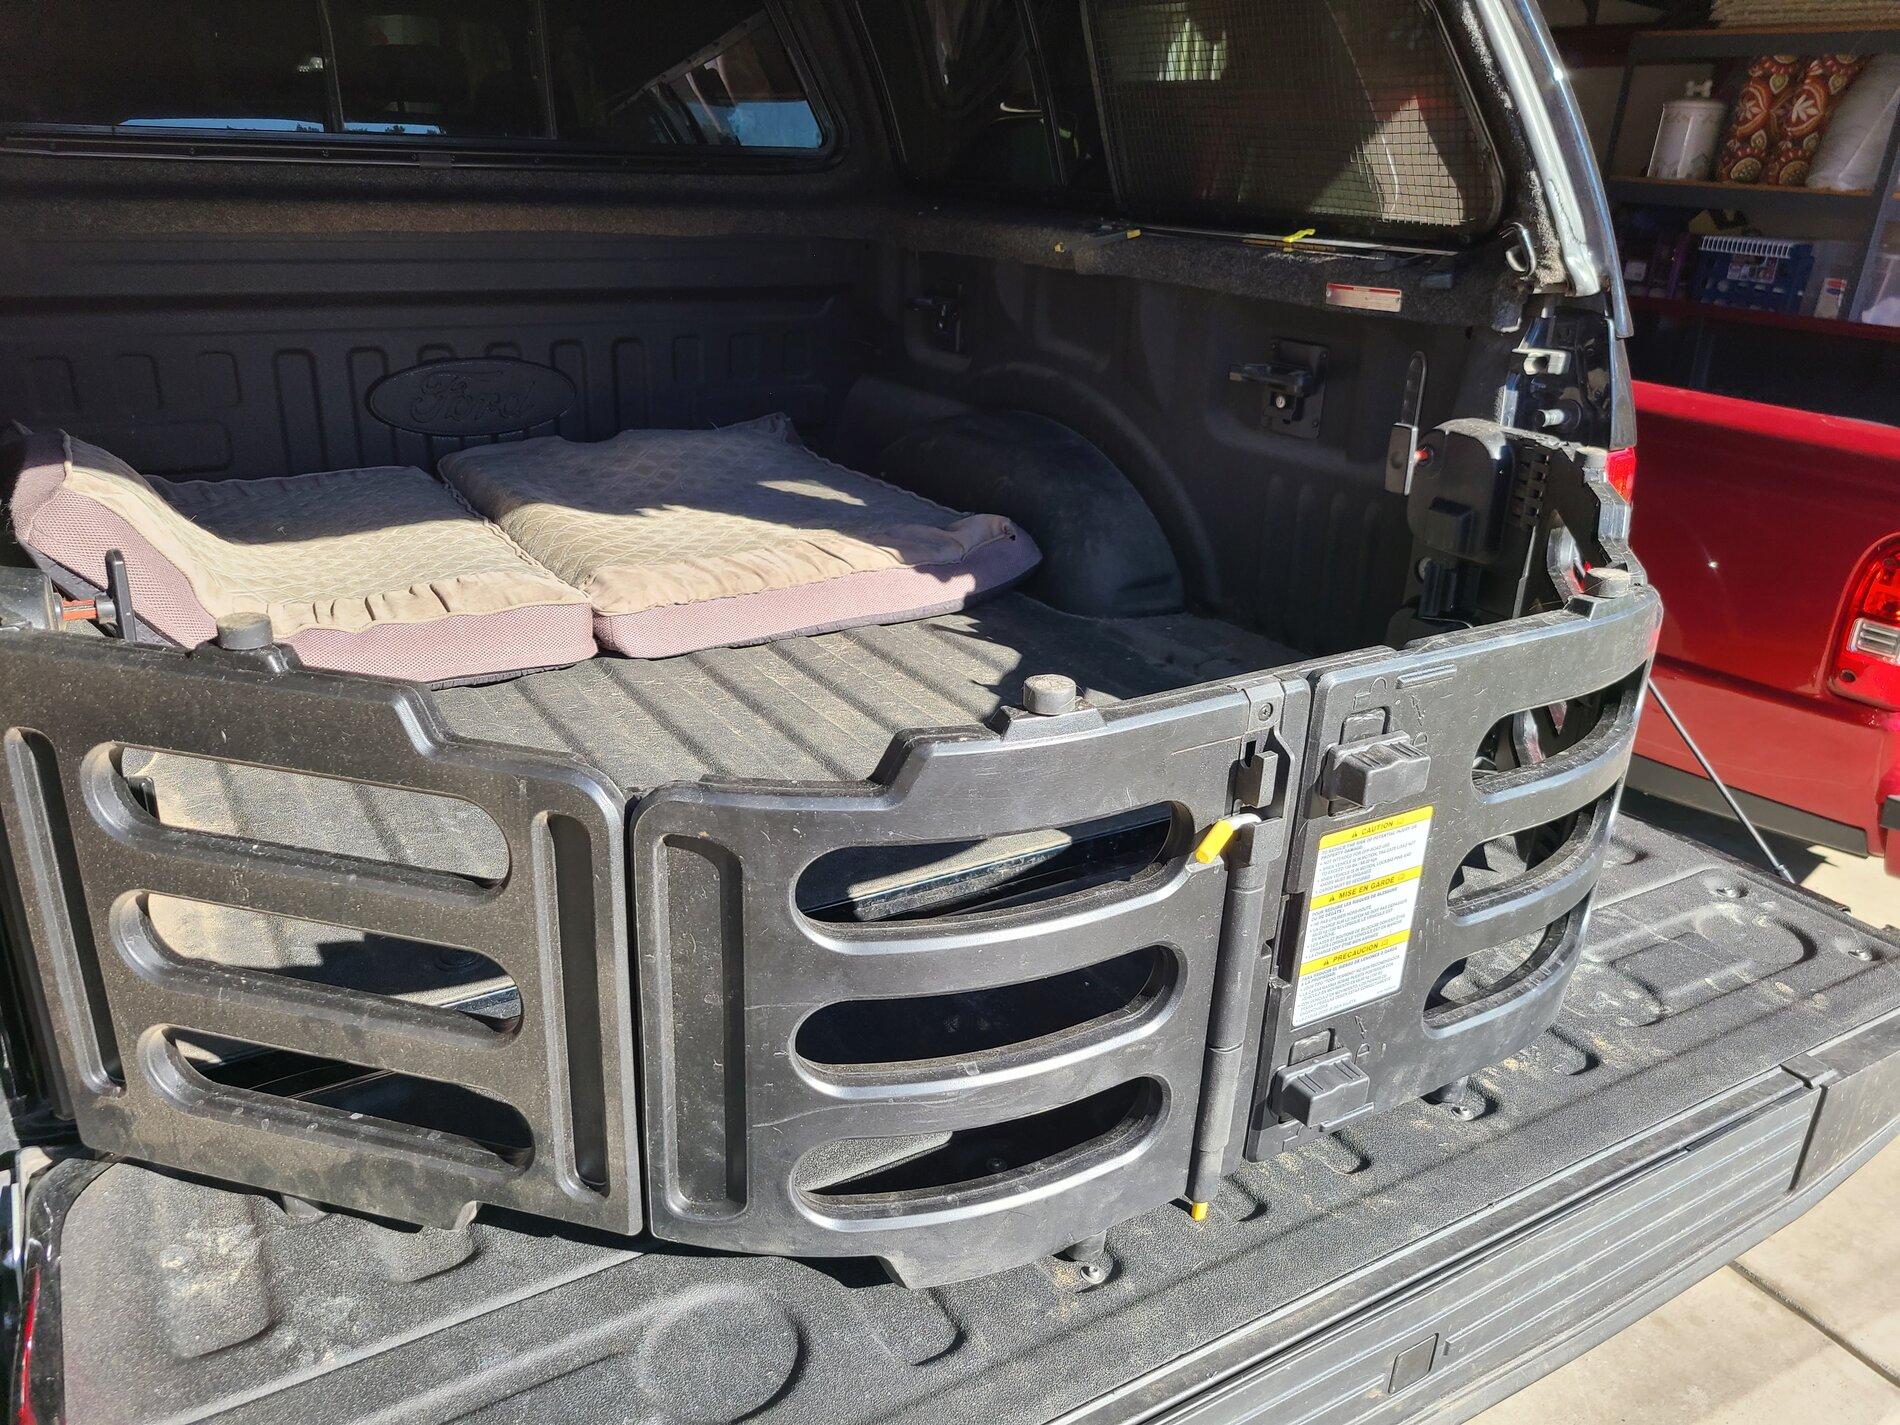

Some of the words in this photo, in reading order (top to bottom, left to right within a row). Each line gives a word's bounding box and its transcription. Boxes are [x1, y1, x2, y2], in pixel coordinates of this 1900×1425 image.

[410, 368, 537, 424] Ford
[1361, 821, 1394, 835] CAUTION
[1338, 888, 1357, 899] MISE
[1358, 884, 1369, 894] EN
[1371, 877, 1395, 890] GARDE
[1333, 943, 1379, 962] PRECAUCION
